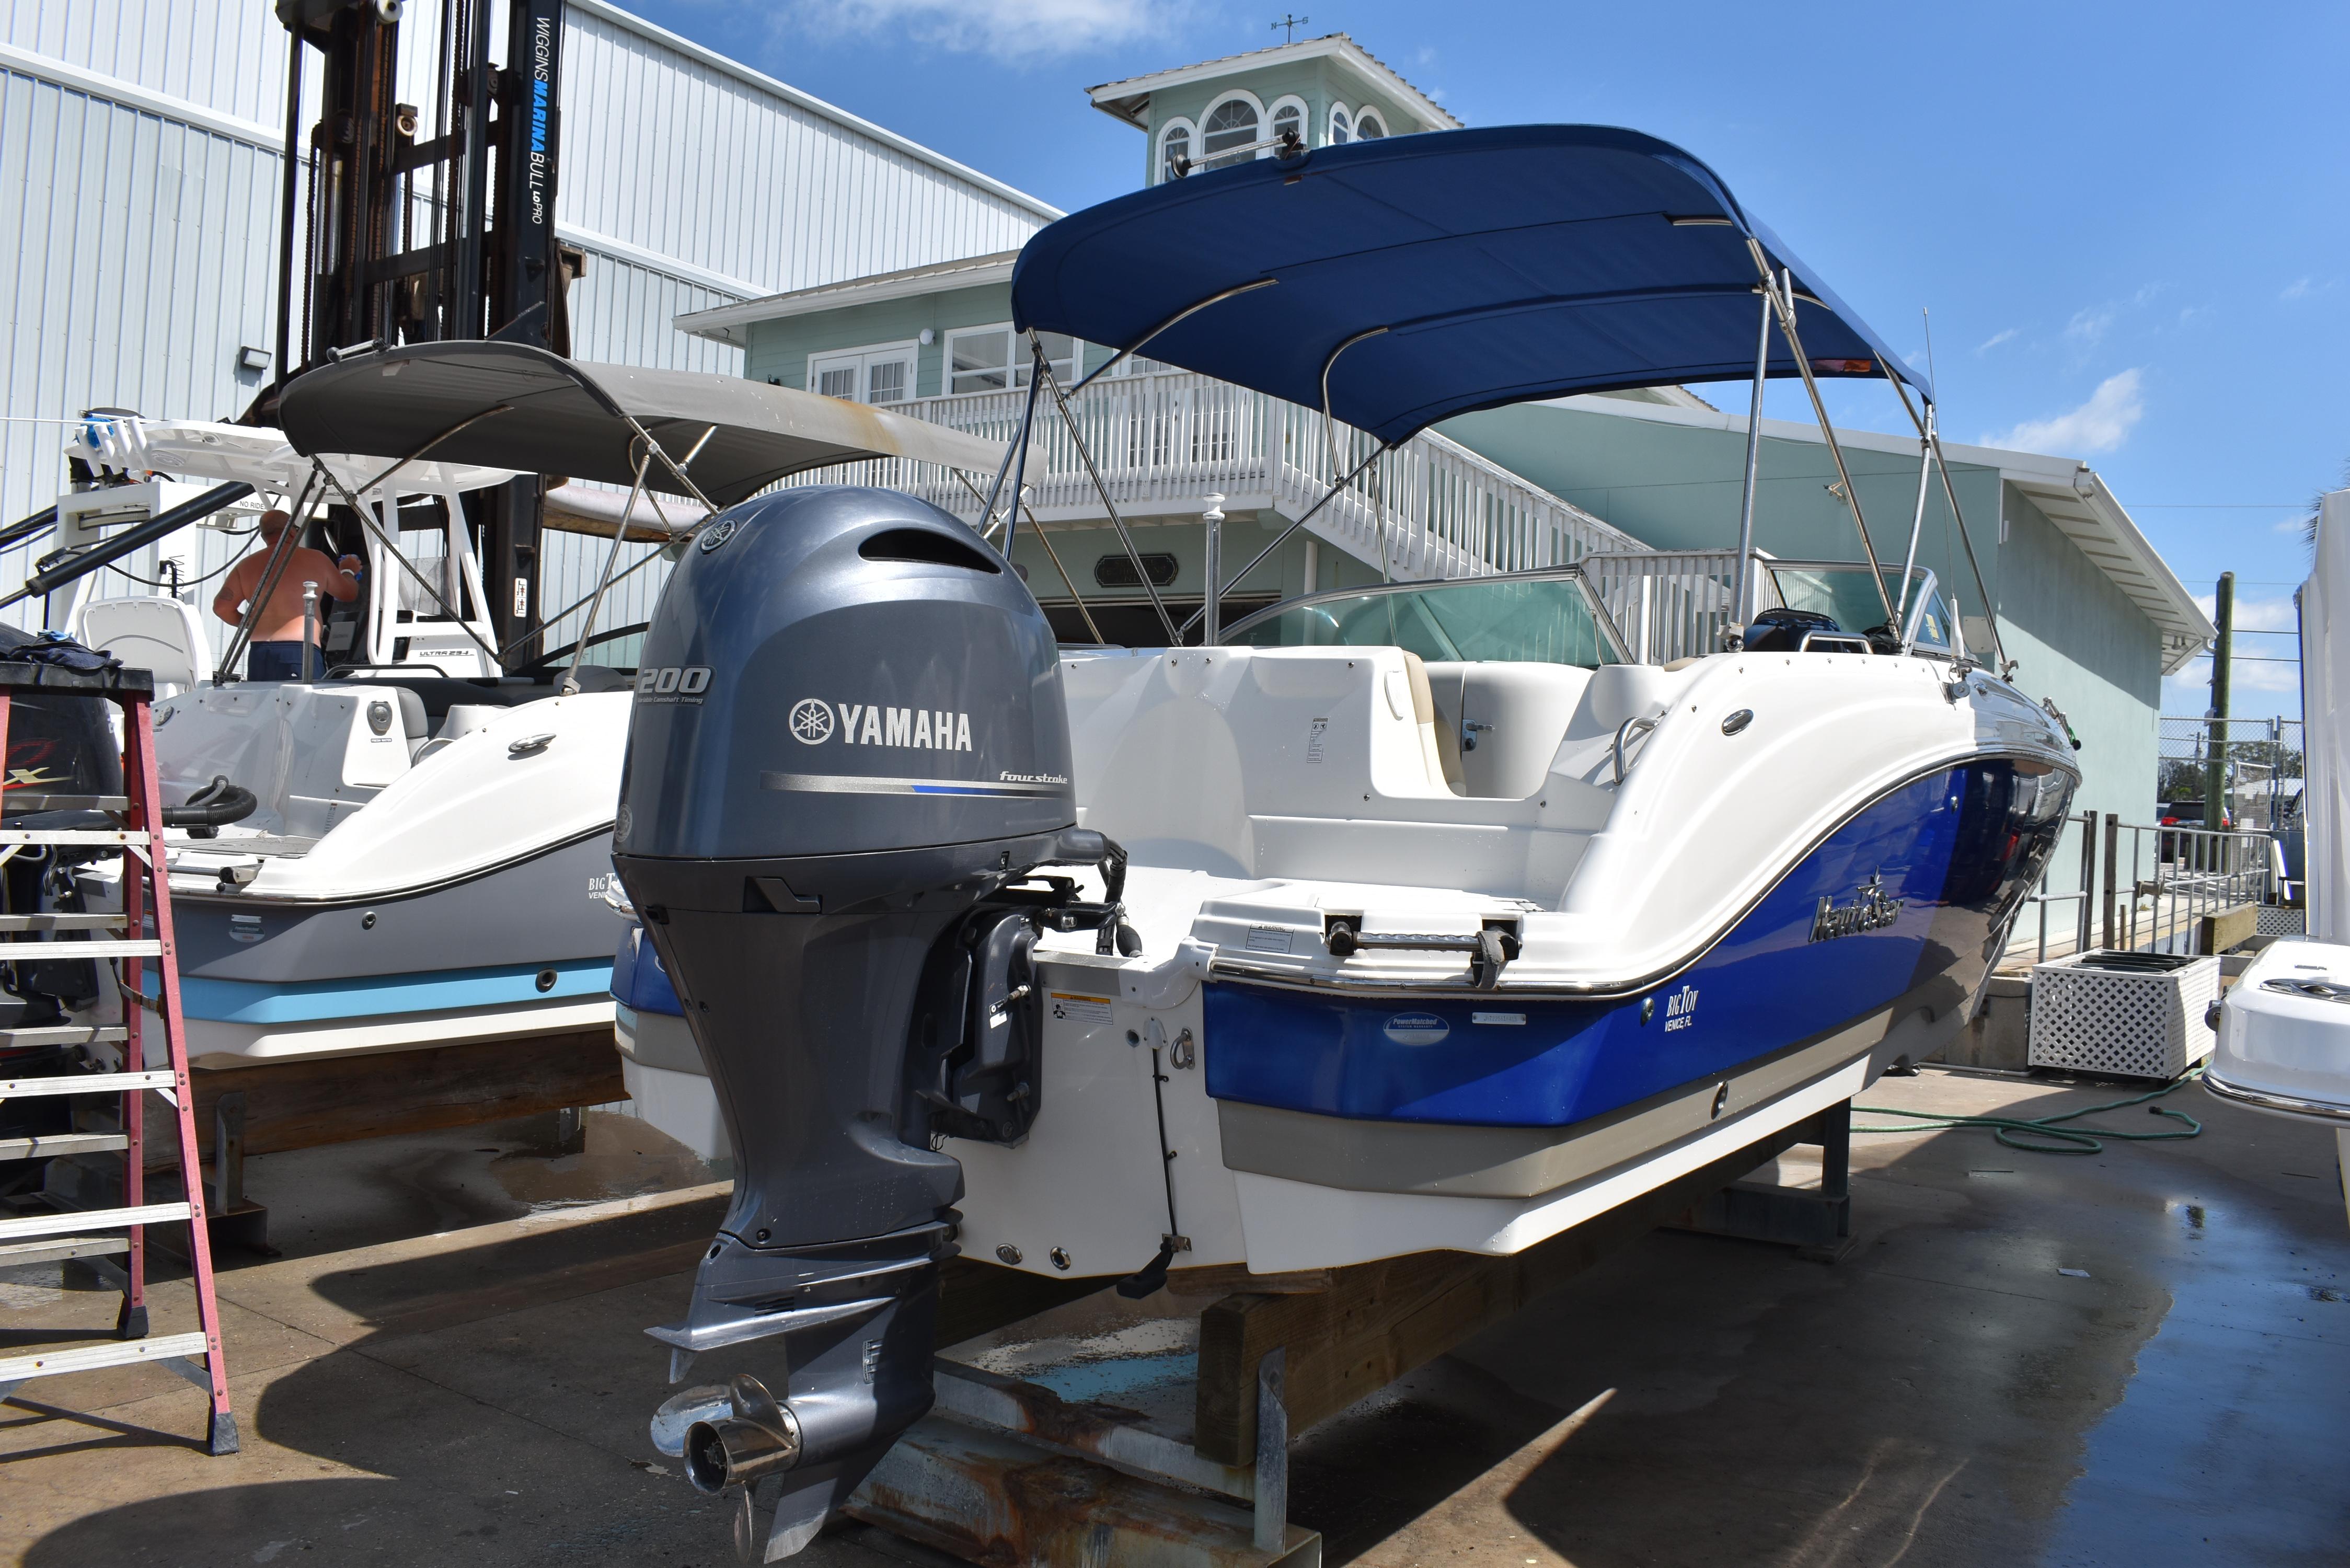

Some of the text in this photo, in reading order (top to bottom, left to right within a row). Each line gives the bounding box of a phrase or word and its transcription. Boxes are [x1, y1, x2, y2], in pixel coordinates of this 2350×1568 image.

[638, 667, 711, 694] 200
[837, 703, 972, 752] YAMAHA
[589, 877, 605, 891] BIG
[1666, 985, 1699, 1017] BIG TOY
